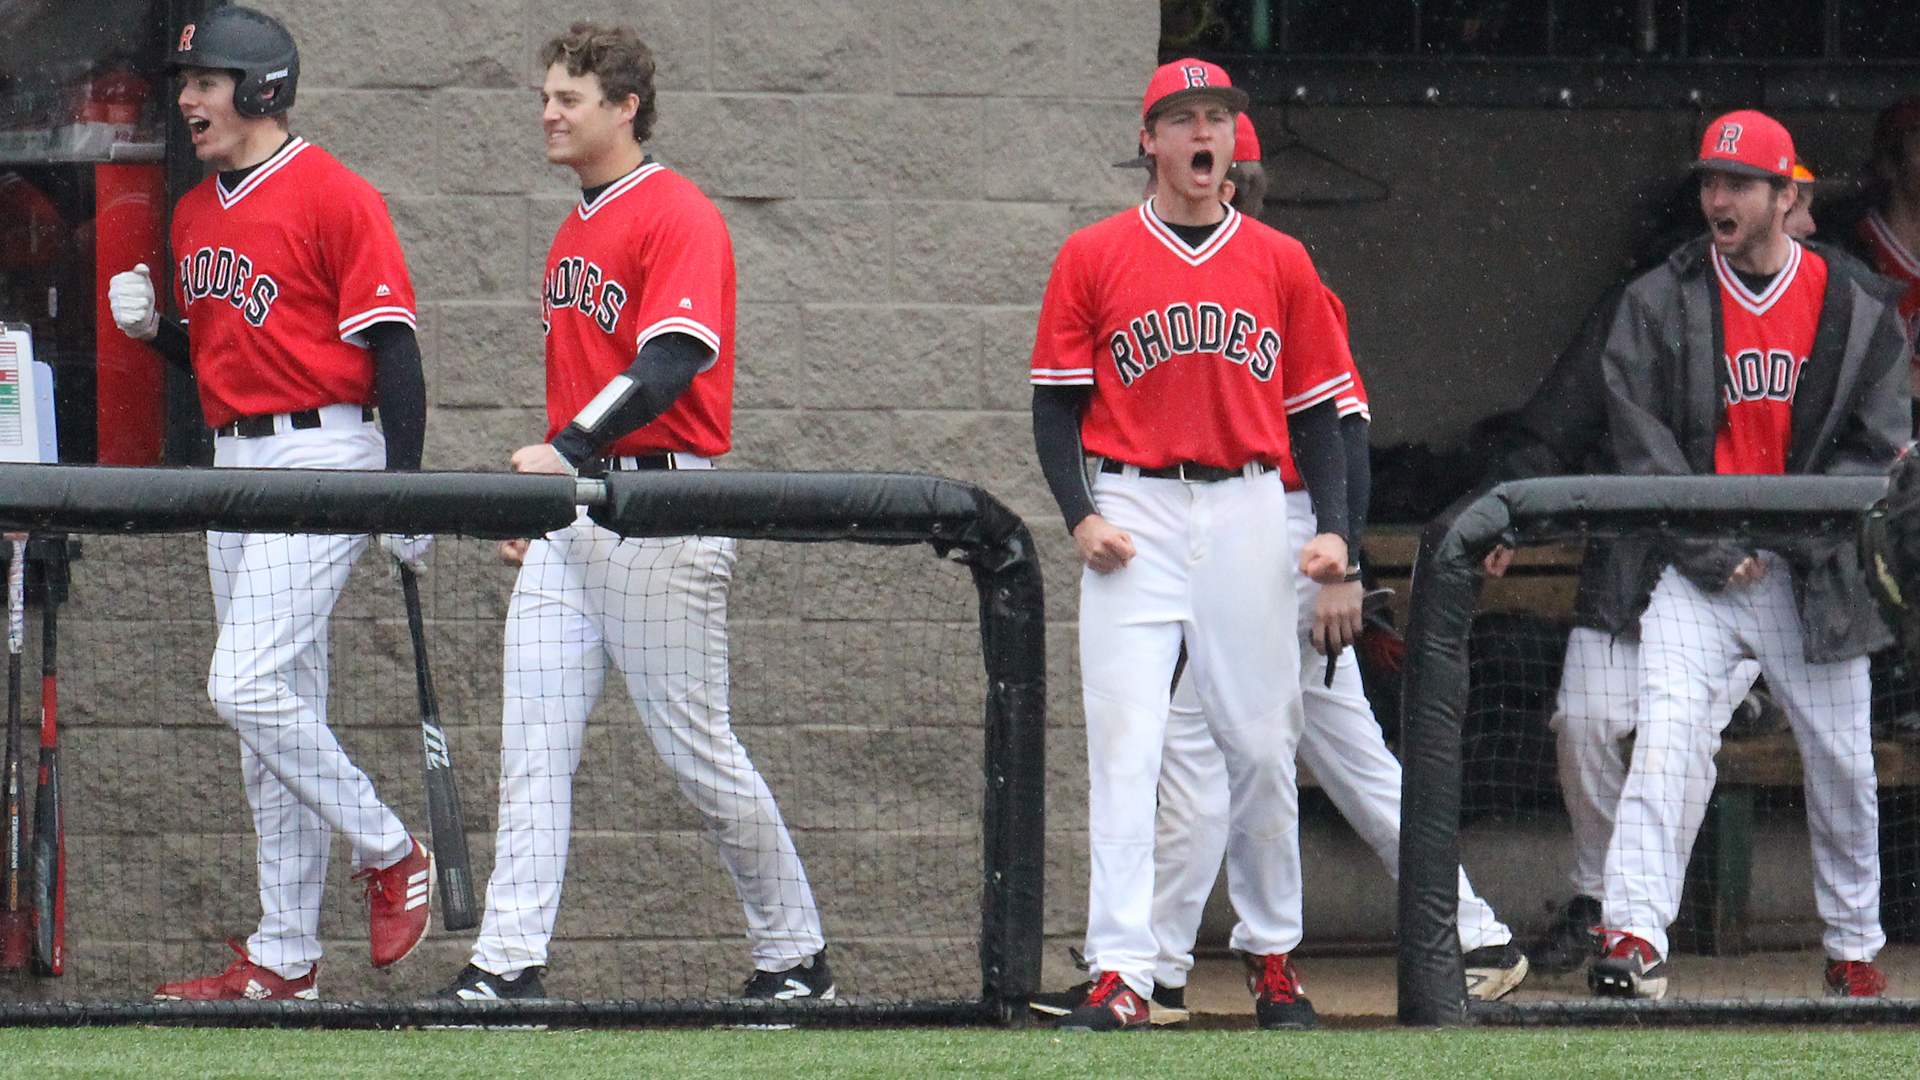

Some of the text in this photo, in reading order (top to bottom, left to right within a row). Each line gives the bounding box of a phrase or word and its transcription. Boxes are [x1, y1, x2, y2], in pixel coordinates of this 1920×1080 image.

[178, 24, 196, 51] R
[1181, 66, 1210, 89] R
[1715, 122, 1743, 154] R
[1110, 302, 1282, 387] RHODES
